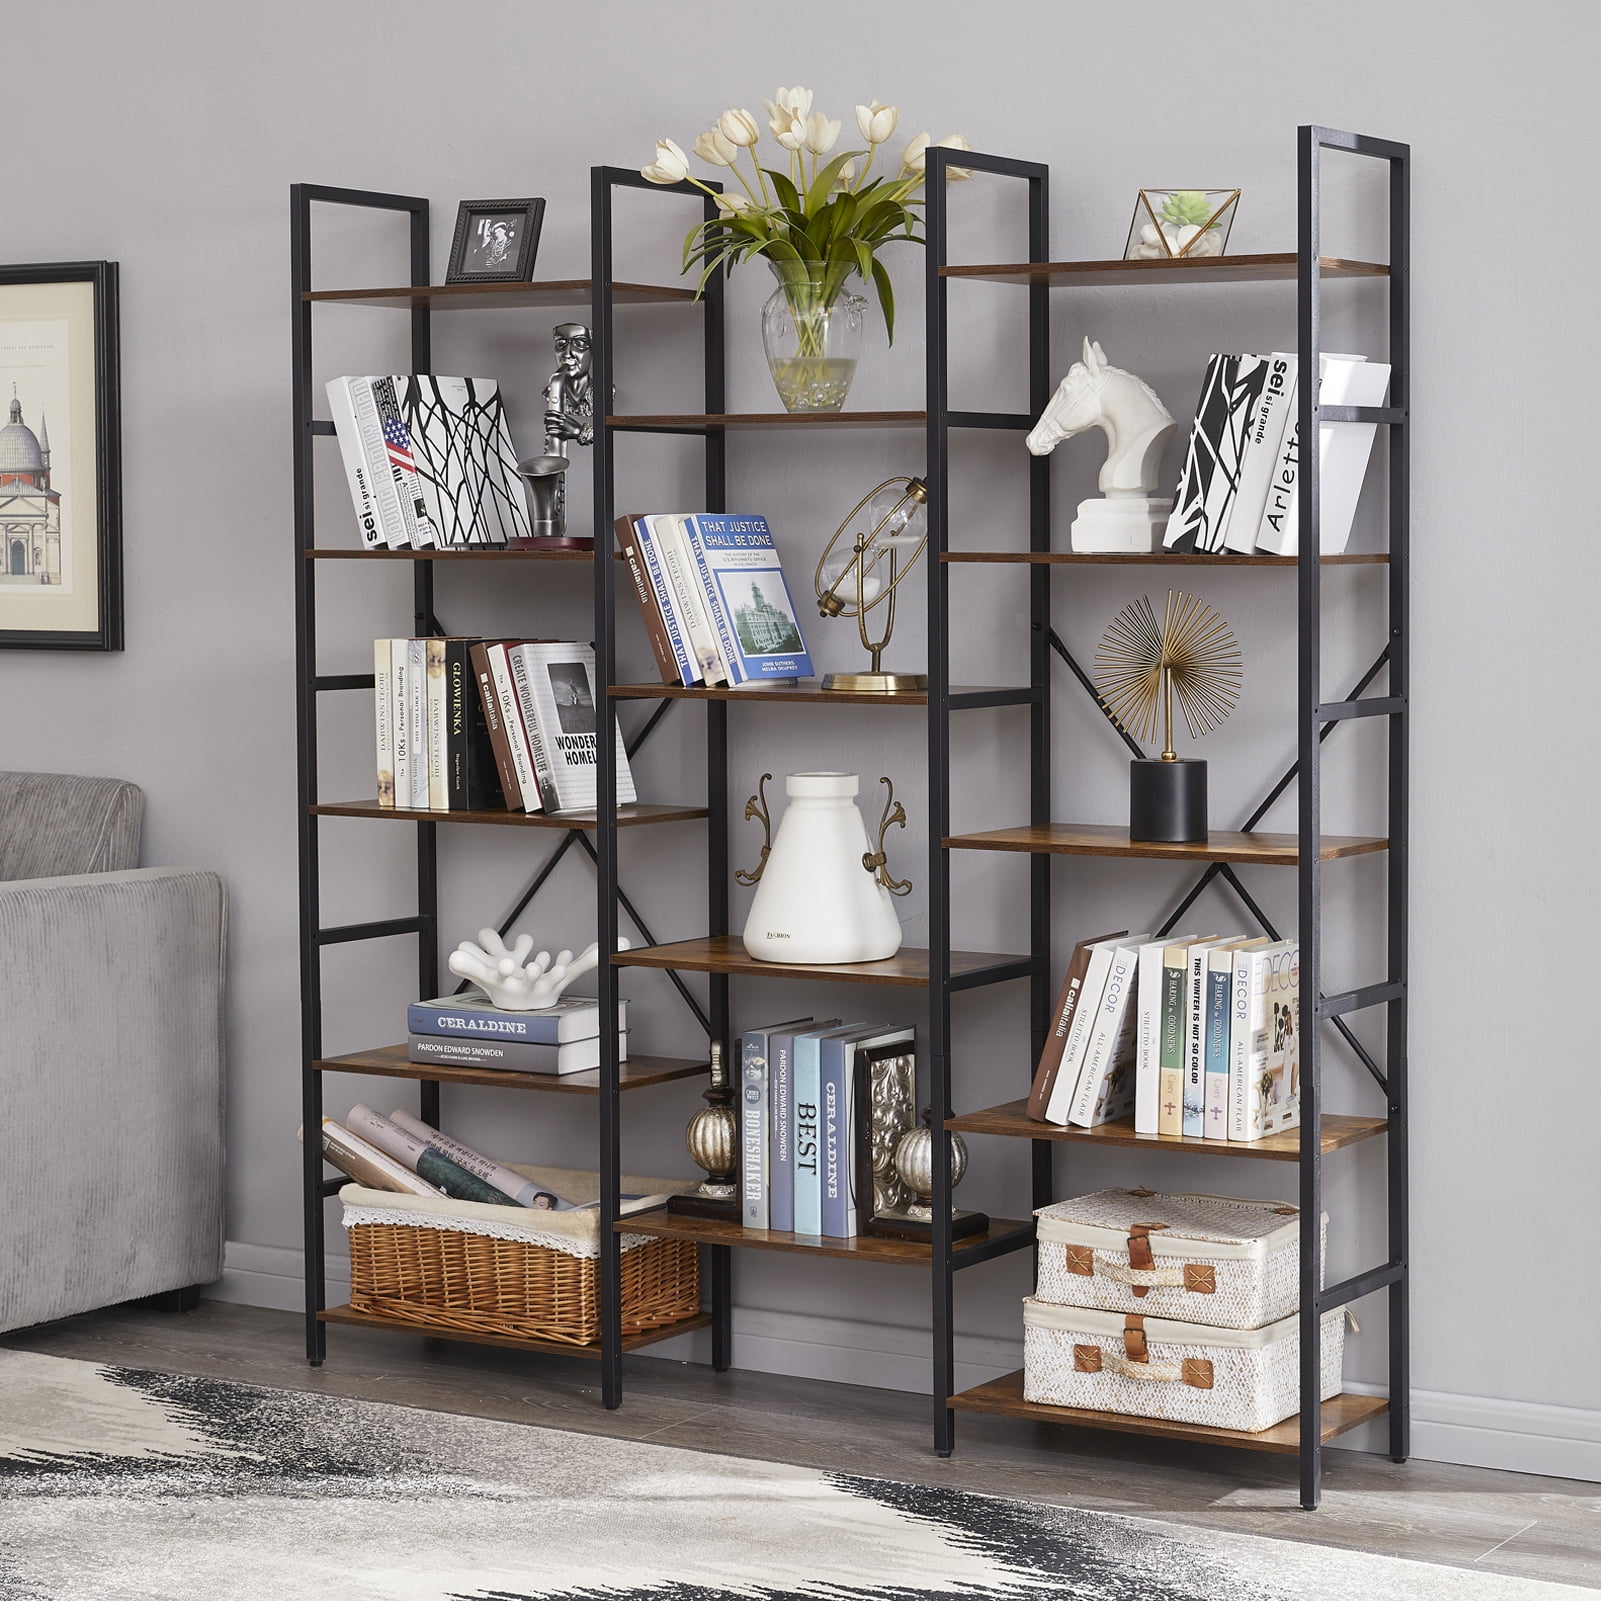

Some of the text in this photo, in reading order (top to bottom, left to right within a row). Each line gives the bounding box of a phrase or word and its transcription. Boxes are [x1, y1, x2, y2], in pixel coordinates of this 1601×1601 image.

[1255, 359, 1287, 444] sei si grande
[356, 468, 378, 542] sei si grande
[702, 522, 767, 532] THAT JUSTICE
[706, 536, 772, 546] SHALL BE DONE
[644, 539, 688, 668] THAT JUSTICE SHALL BE DONE
[691, 536, 737, 664] THAT JUSTICE SHALL BE DONE
[512, 655, 547, 773] CREATE WONDERFUL HOMELIFE
[509, 720, 520, 751] Personal
[517, 754, 526, 784] Branding
[555, 735, 597, 750] WONDER
[565, 750, 597, 765] HOMEL
[1104, 965, 1126, 1013] DECOR
[1236, 970, 1248, 1020] DECOR
[1261, 949, 1299, 995] DECO
[1193, 1013, 1199, 1022] IS
[417, 1043, 504, 1057] PARDON EDWARD SNOWDEN
[1192, 1042, 1199, 1054] SO
[746, 1110, 761, 1200] BONESHAKER
[798, 1103, 817, 1176] BEST
